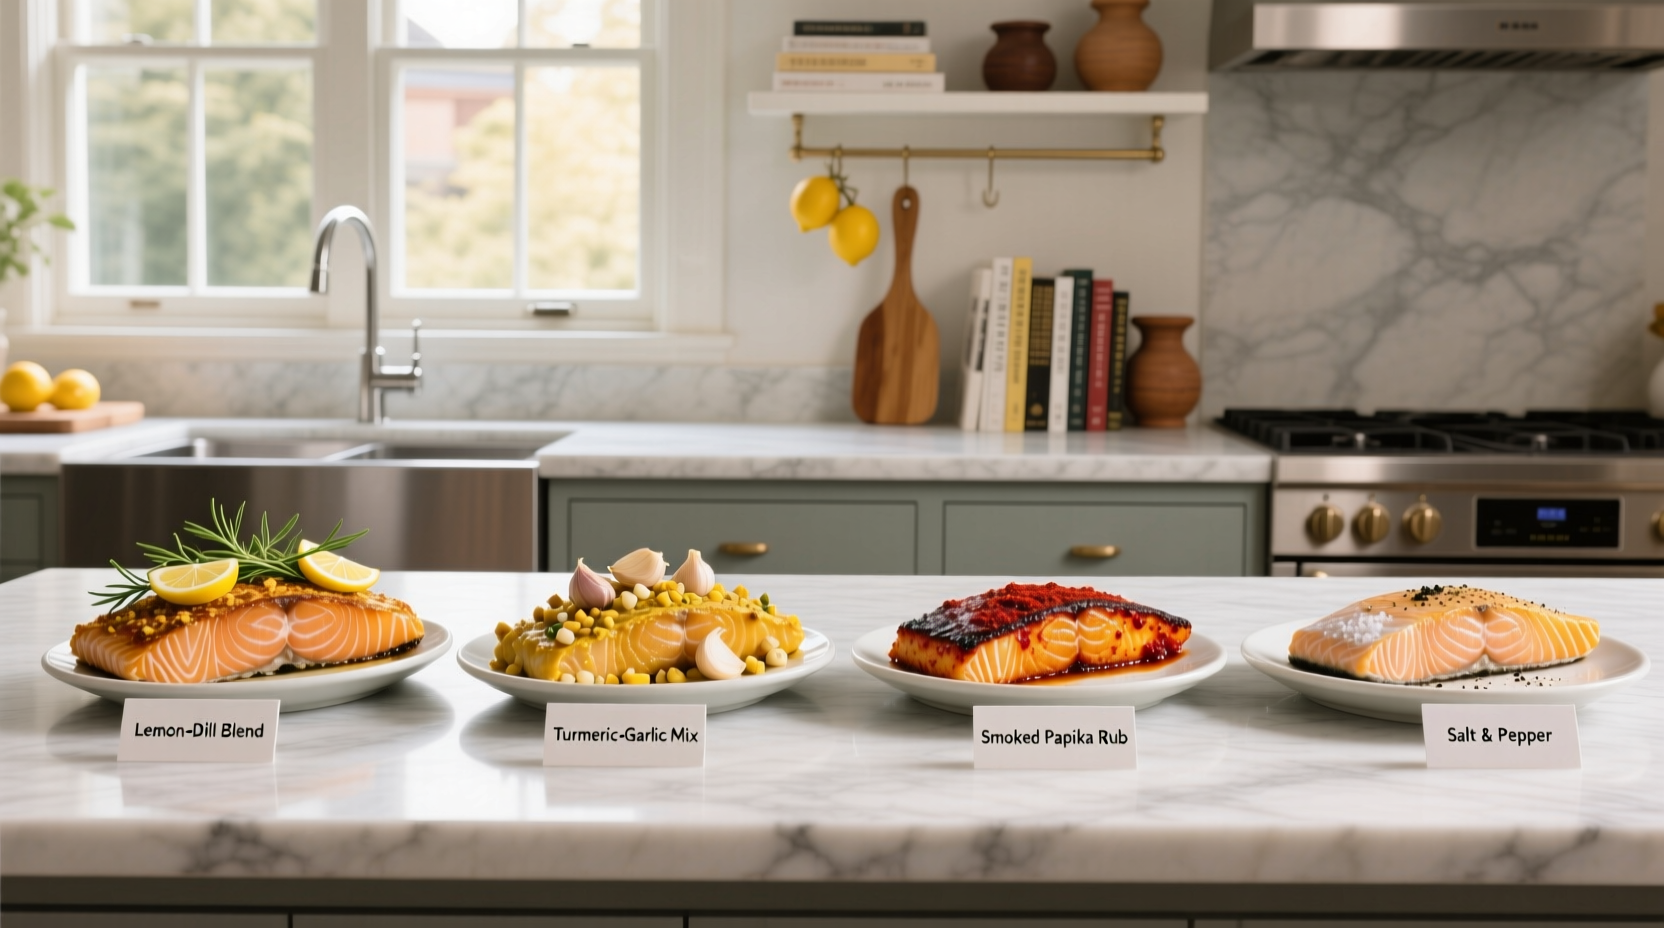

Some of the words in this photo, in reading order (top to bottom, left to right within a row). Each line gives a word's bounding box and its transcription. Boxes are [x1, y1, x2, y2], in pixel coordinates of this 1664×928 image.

[134, 722, 217, 738] Lemon-Dill
[220, 721, 265, 739] Blend
[553, 726, 668, 743] Turmeric-Garlic
[670, 726, 699, 743] Mix
[981, 728, 1040, 745] Smoked
[1044, 728, 1094, 749] Papika
[1098, 729, 1129, 745] Rub
[1447, 726, 1477, 743] Salt
[1481, 727, 1493, 743] &
[1497, 727, 1553, 747] Pepper
